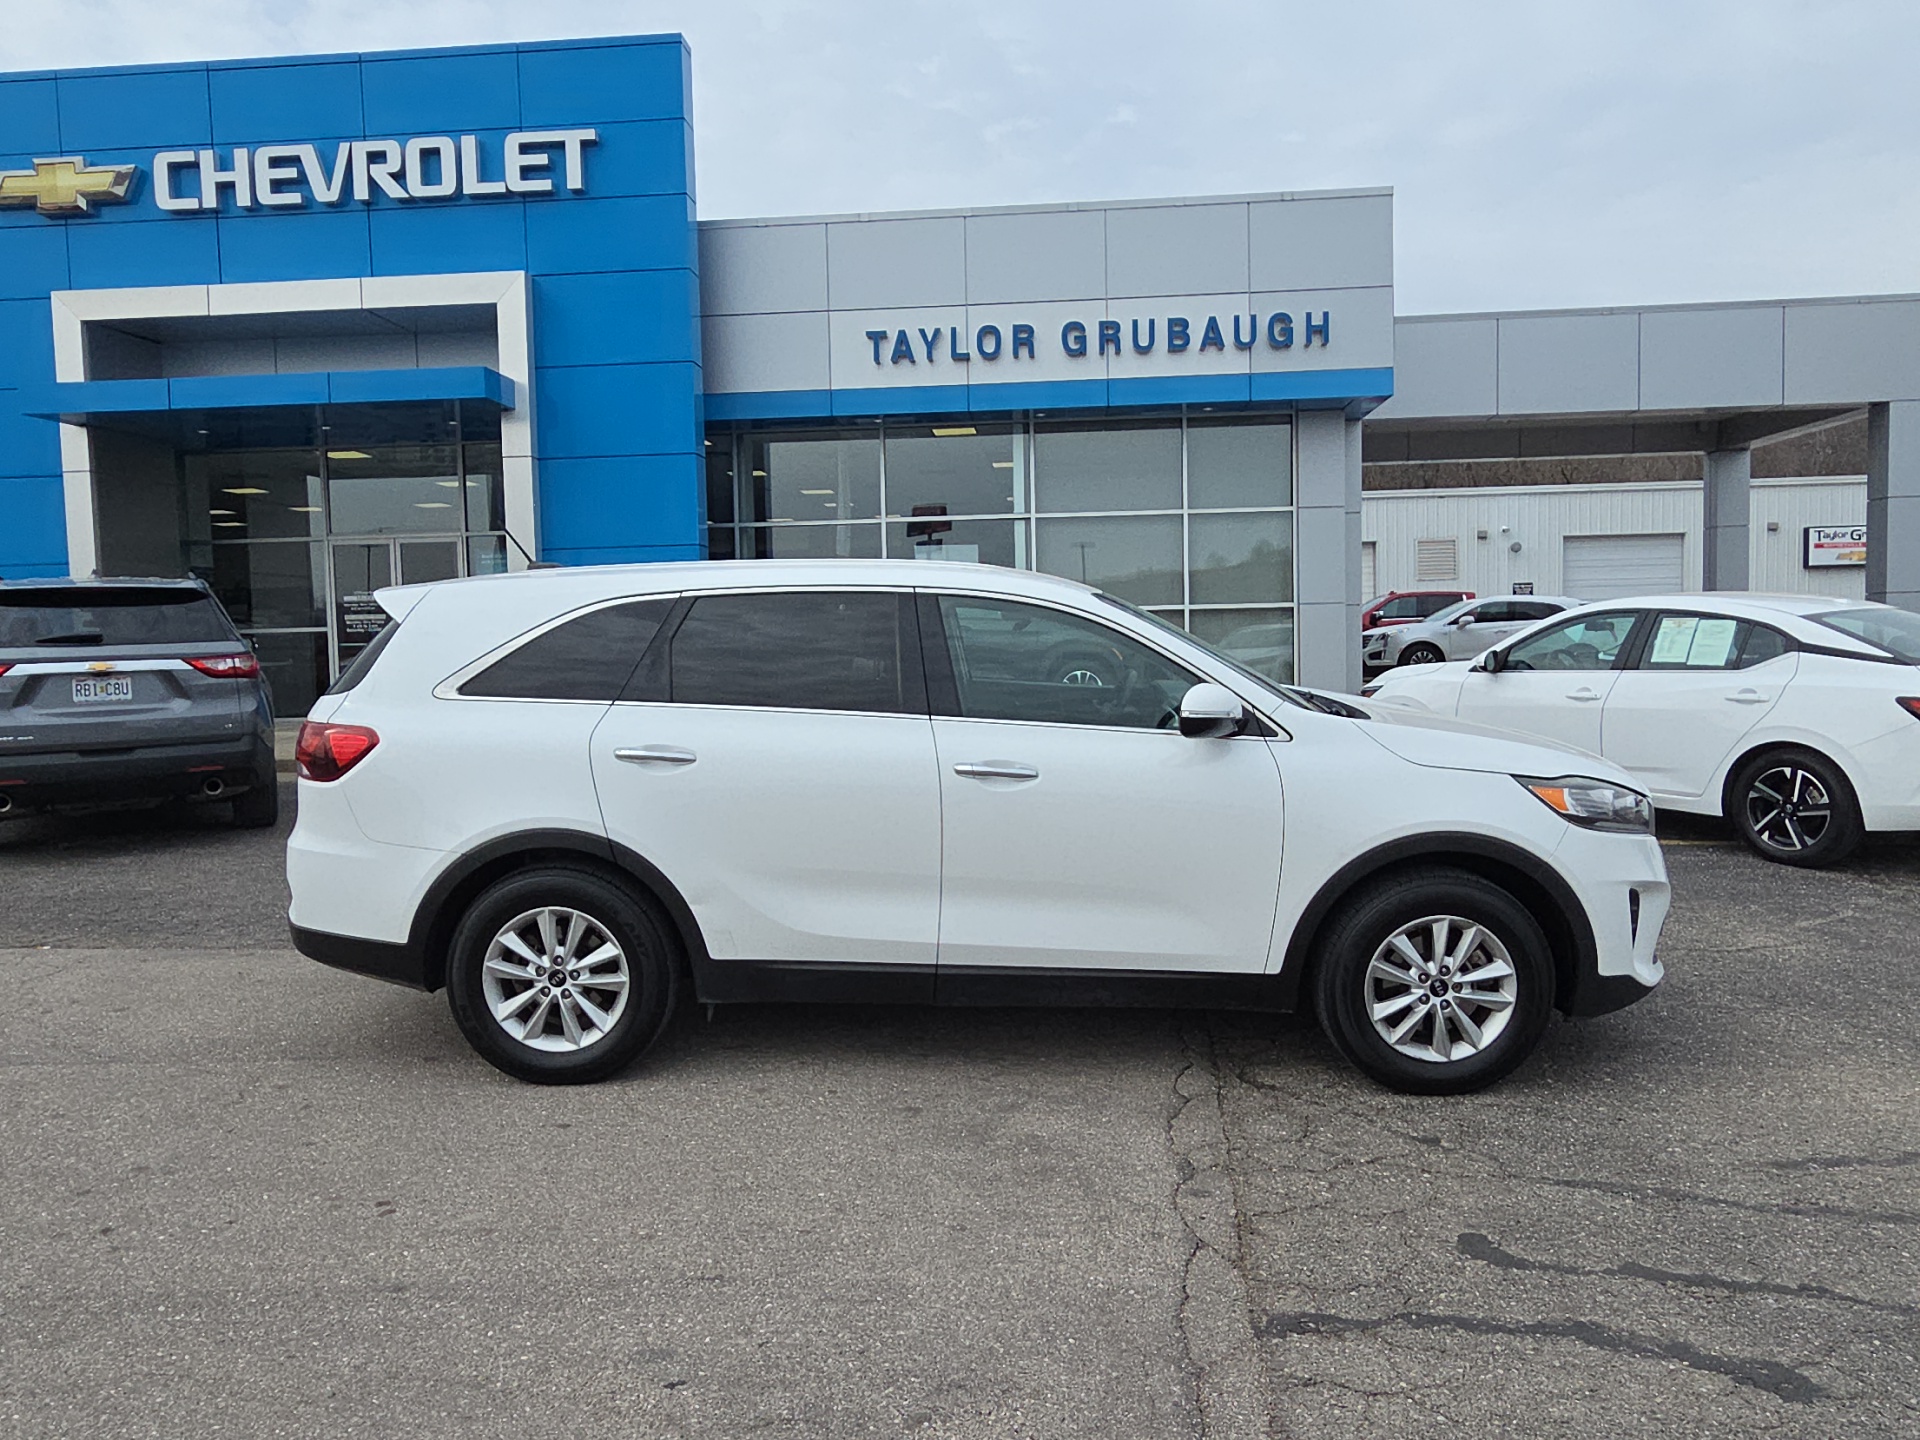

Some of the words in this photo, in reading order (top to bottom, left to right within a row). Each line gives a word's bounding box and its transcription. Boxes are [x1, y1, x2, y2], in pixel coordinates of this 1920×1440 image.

[153, 129, 597, 211] CHEVROLET
[865, 323, 1036, 366] TAYLOR
[1061, 311, 1331, 357] GRUBAUGH
[1814, 529, 1848, 541] Taylor
